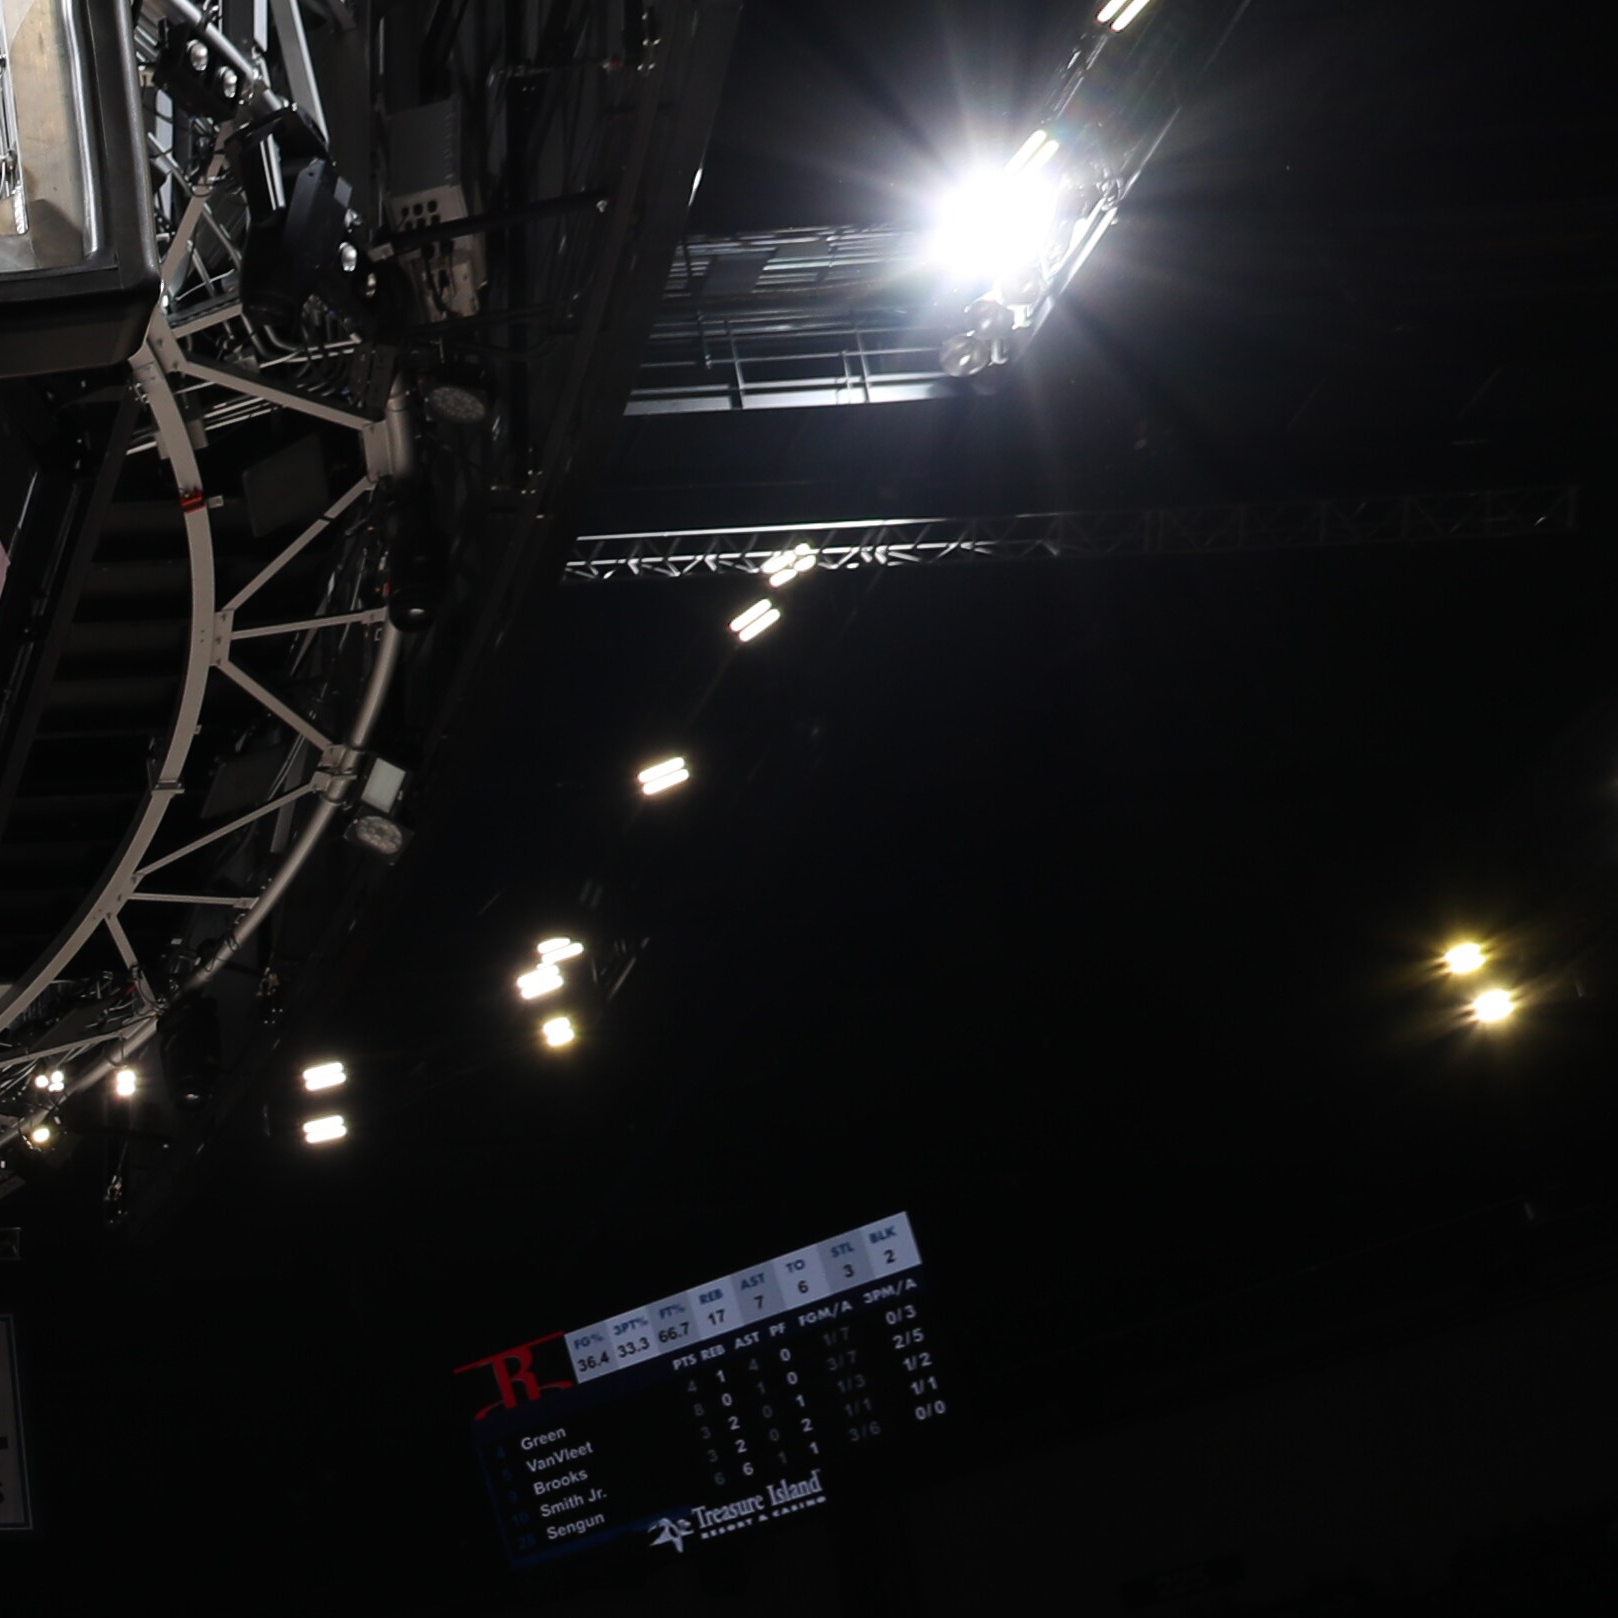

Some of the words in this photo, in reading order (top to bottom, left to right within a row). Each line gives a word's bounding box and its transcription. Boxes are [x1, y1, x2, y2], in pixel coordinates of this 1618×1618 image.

[520, 1427, 567, 1451] Green
[525, 1440, 594, 1473] VanVleet
[533, 1469, 588, 1496] Brooks
[539, 1493, 584, 1518] Smith
[587, 1488, 607, 1503] Jr.
[691, 1494, 765, 1529] Treasure
[765, 1471, 823, 1507] Island
[546, 1513, 605, 1540] Sengun
